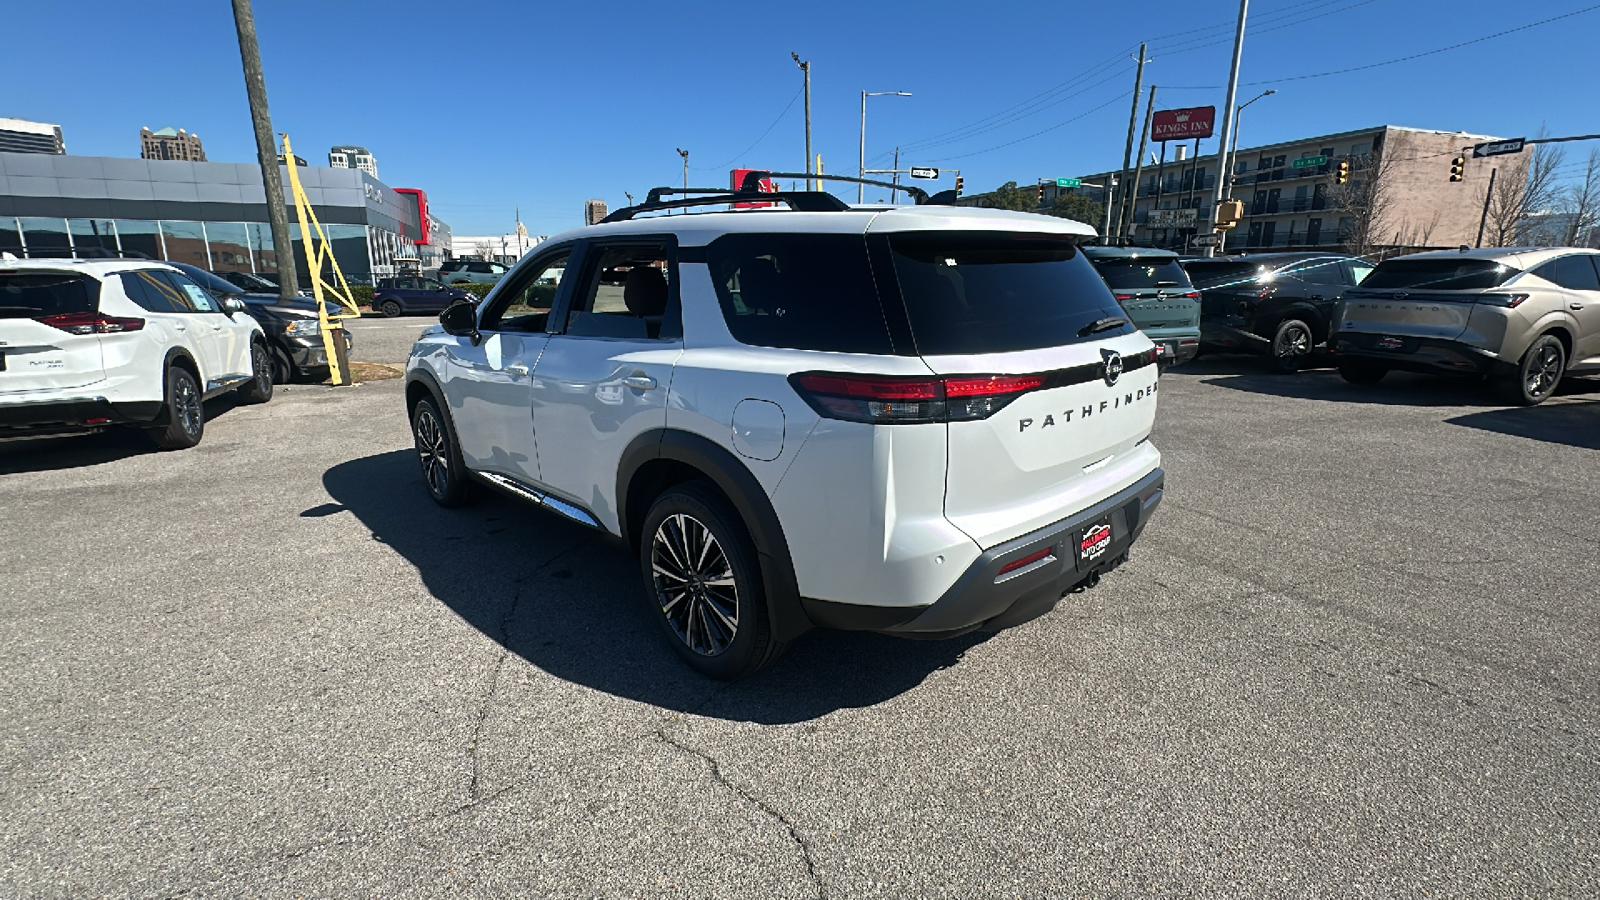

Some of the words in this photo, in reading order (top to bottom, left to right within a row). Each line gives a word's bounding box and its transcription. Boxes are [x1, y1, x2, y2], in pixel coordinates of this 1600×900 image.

[1155, 123, 1187, 134] KINGS
[1190, 121, 1210, 131] INN
[1019, 381, 1158, 432] PATHFINDER
[1081, 546, 1096, 560] AUTO
[1095, 535, 1111, 551] GROUP
